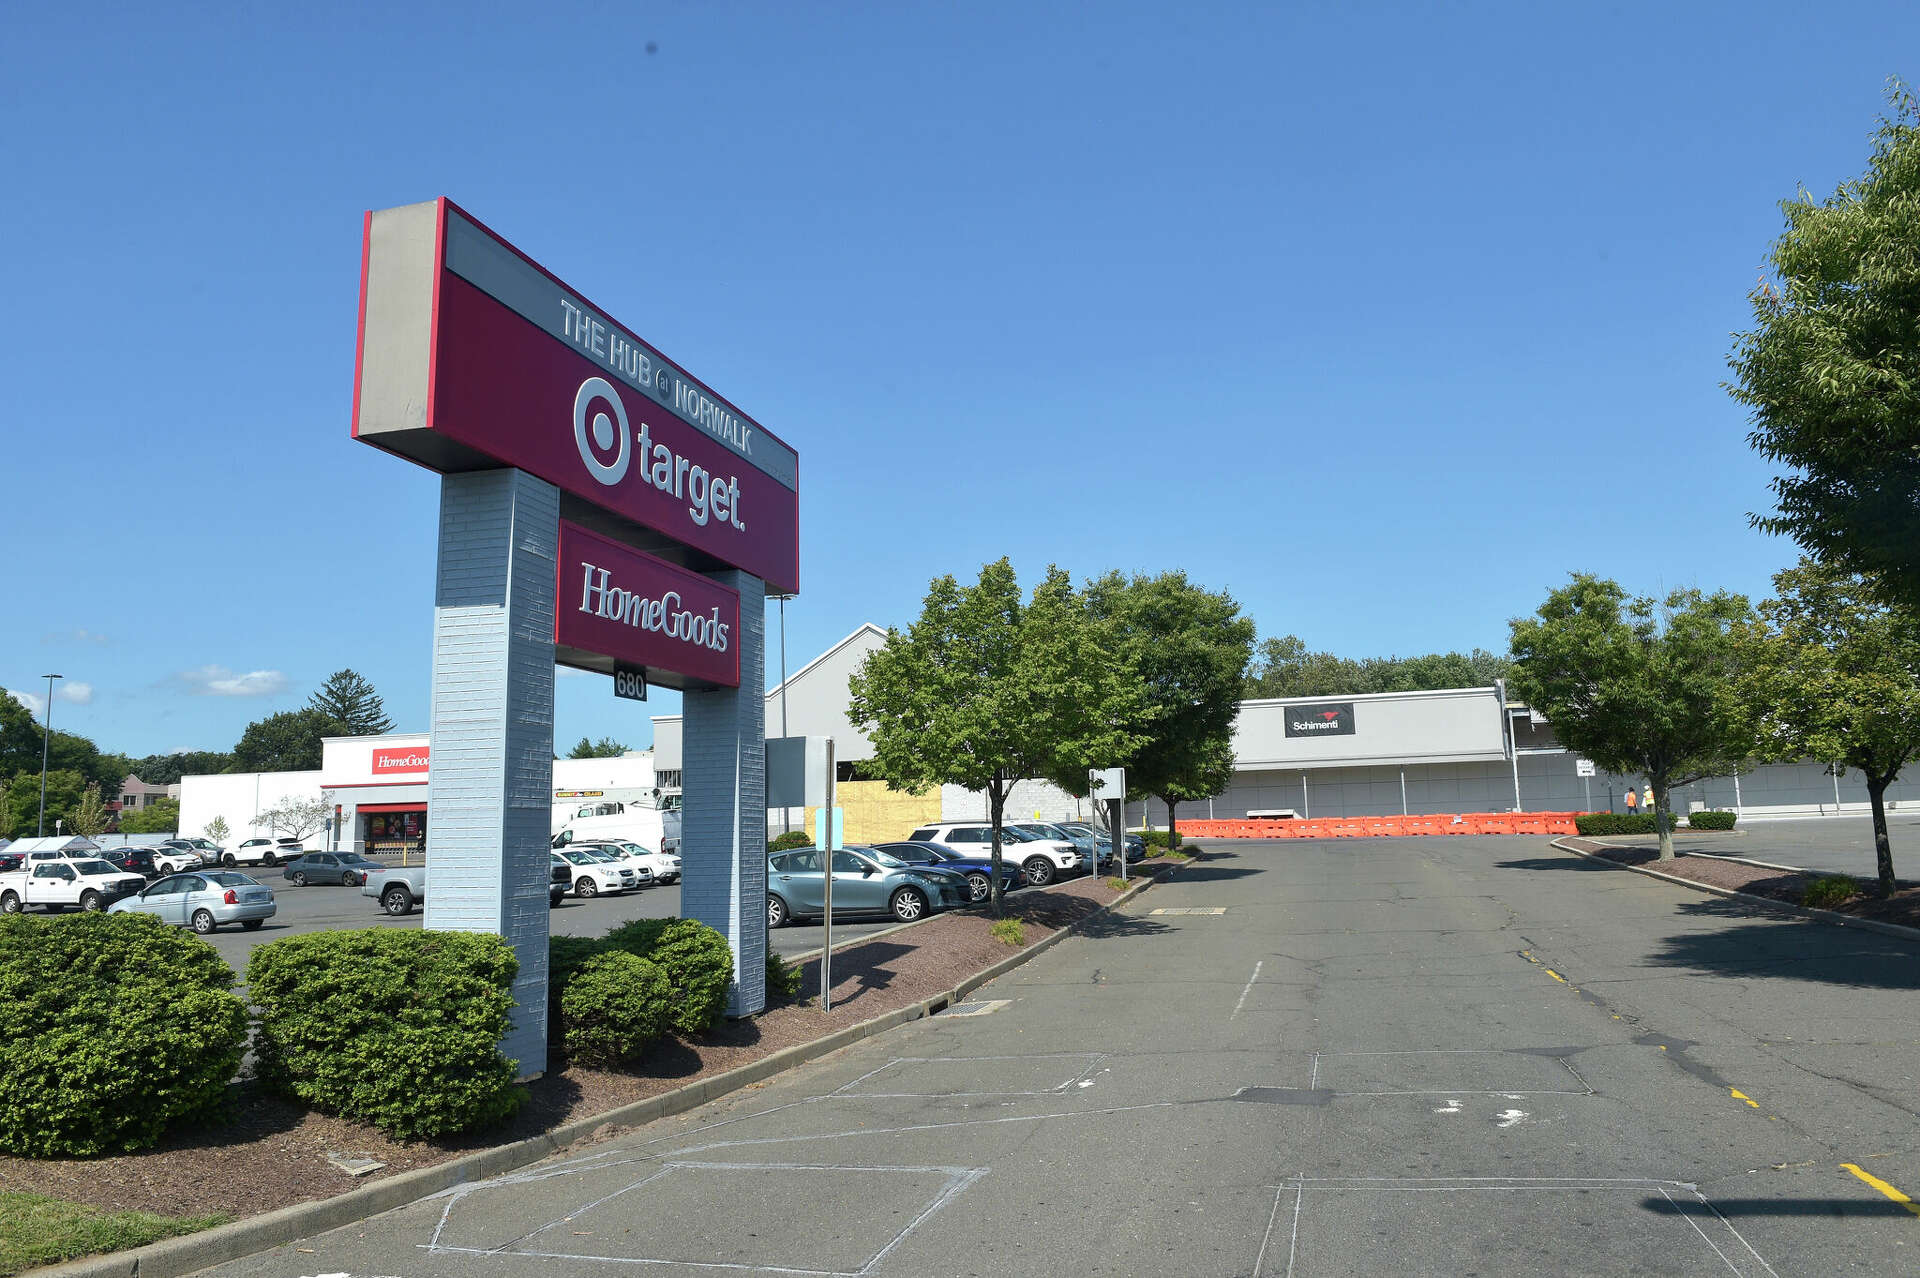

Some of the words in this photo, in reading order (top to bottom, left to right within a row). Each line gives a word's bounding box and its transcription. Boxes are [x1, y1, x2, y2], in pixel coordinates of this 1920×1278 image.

[560, 299, 606, 359] THE
[610, 333, 652, 387] HUB
[675, 379, 753, 456] NORWALK
[579, 562, 729, 653] HomeGoods
[617, 671, 644, 699] 680
[1293, 720, 1339, 730] Schimenti
